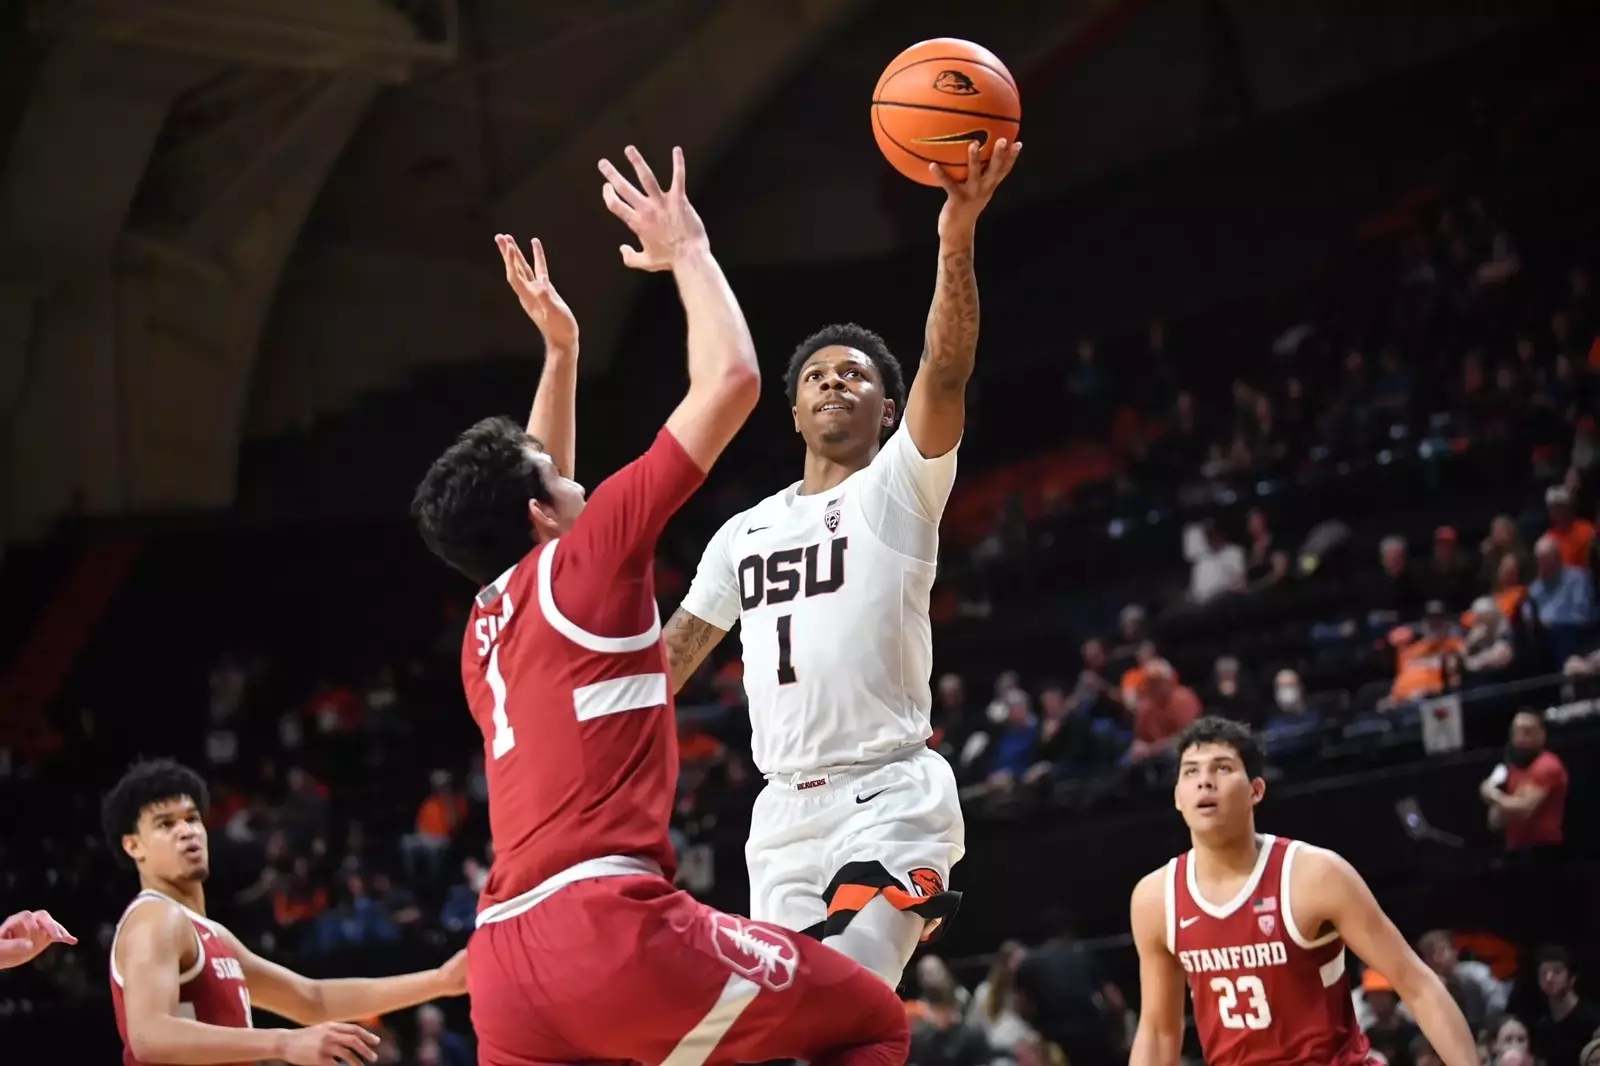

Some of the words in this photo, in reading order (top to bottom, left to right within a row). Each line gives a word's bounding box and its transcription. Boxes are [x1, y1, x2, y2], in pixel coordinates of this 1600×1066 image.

[738, 536, 848, 612] OSU
[776, 614, 798, 686] 1
[485, 643, 516, 760] 1
[797, 778, 826, 790] BEAVERS
[1178, 941, 1288, 973] STANFORD
[1210, 975, 1272, 1030] 23
